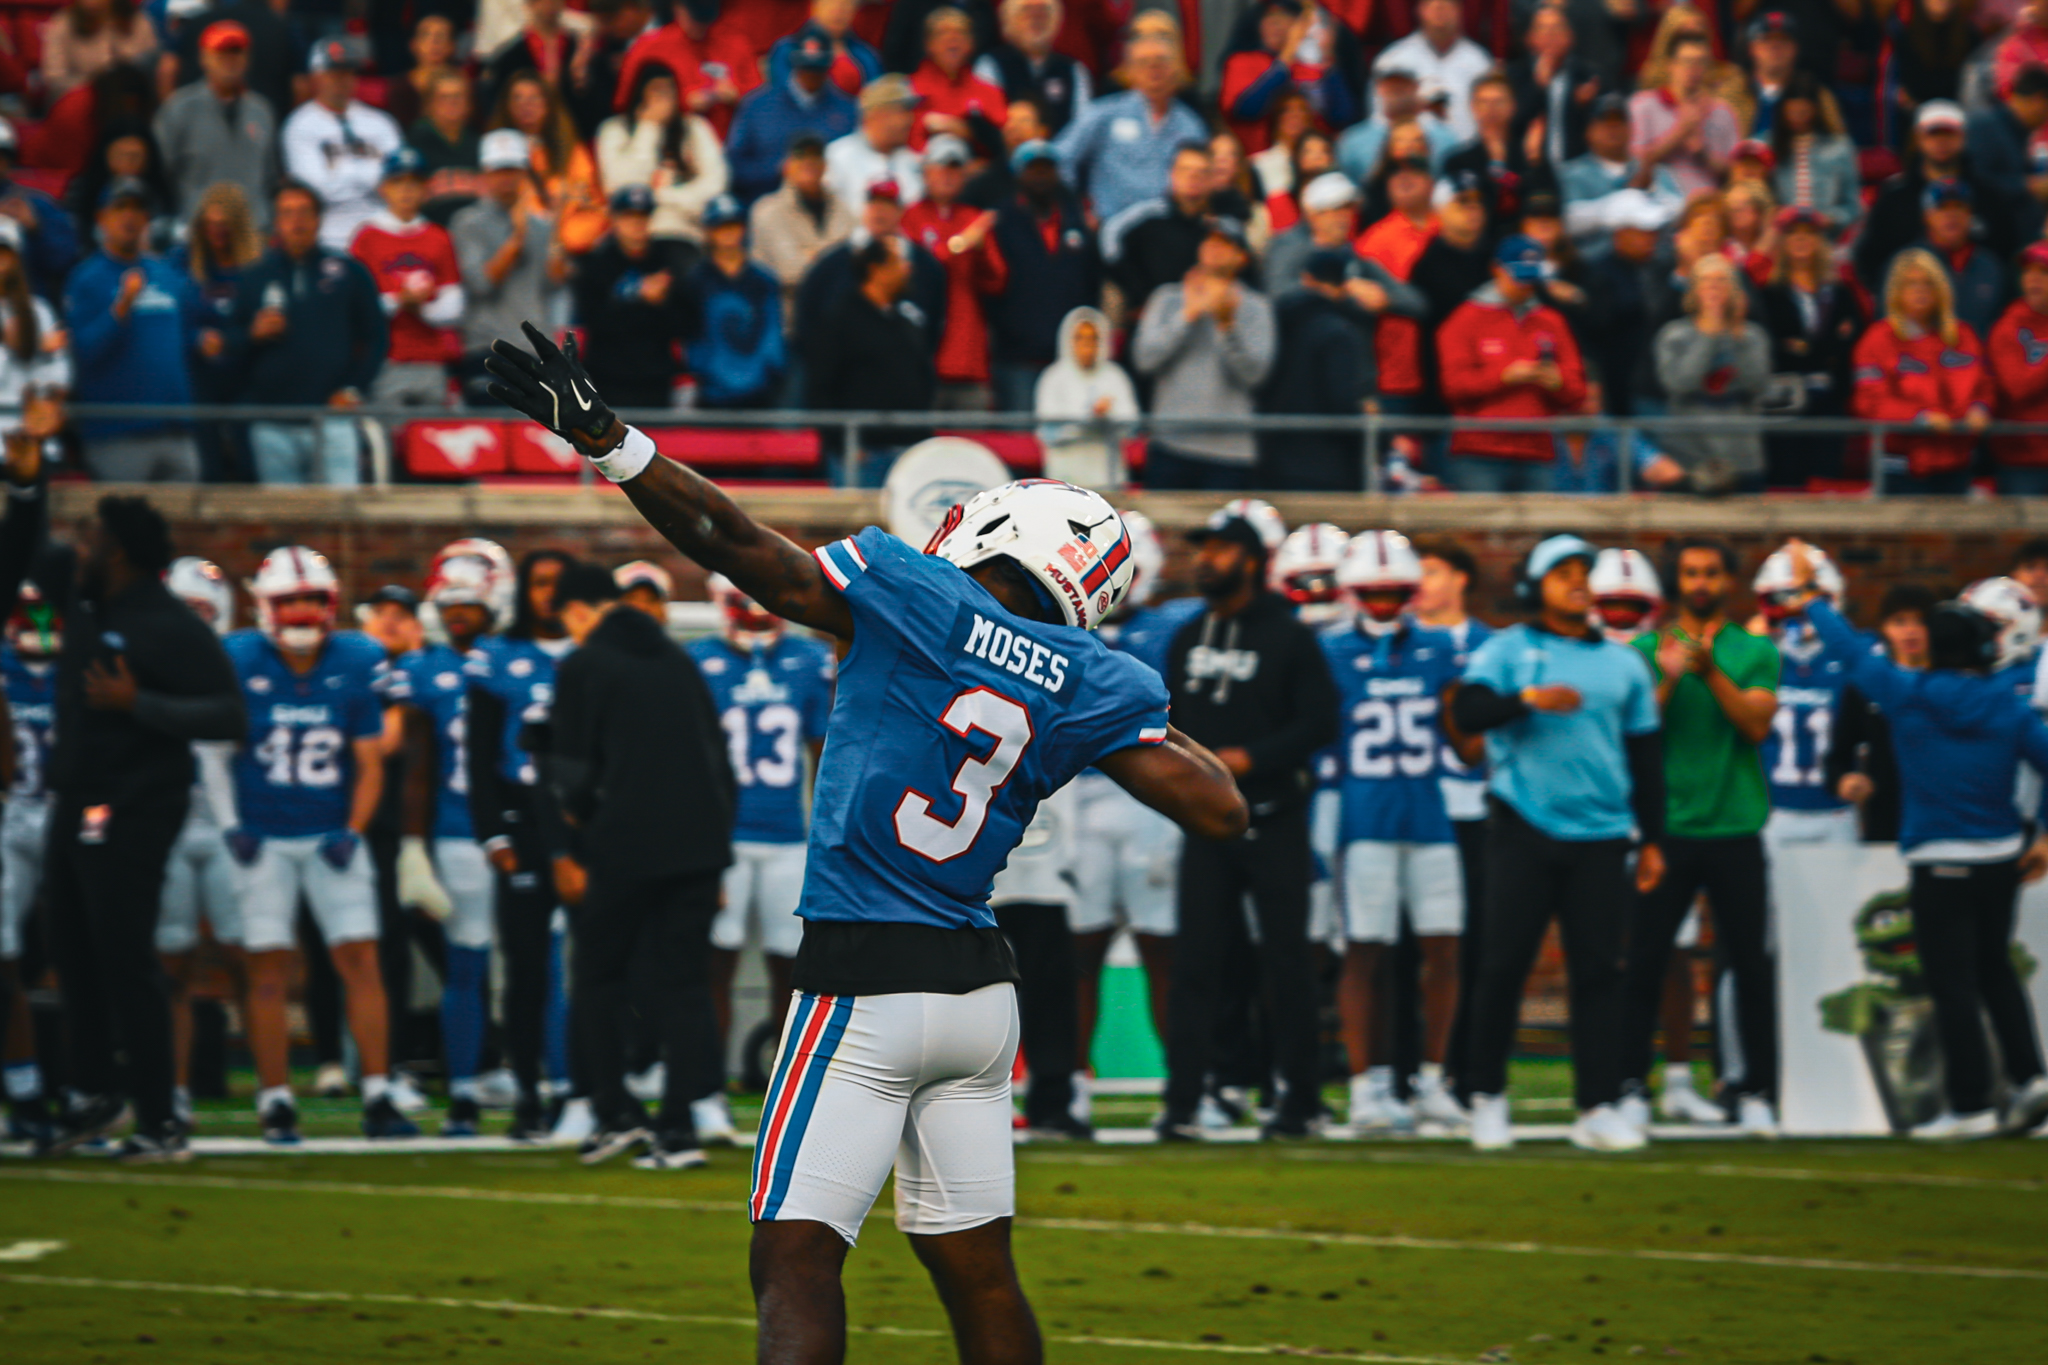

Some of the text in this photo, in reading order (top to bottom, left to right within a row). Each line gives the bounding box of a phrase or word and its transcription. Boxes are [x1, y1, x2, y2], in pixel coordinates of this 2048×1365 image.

[963, 613, 1069, 694] MOSES
[722, 704, 799, 786] 13
[891, 684, 1036, 866] 3
[1351, 698, 1436, 777] 25
[1772, 706, 1831, 785] 11
